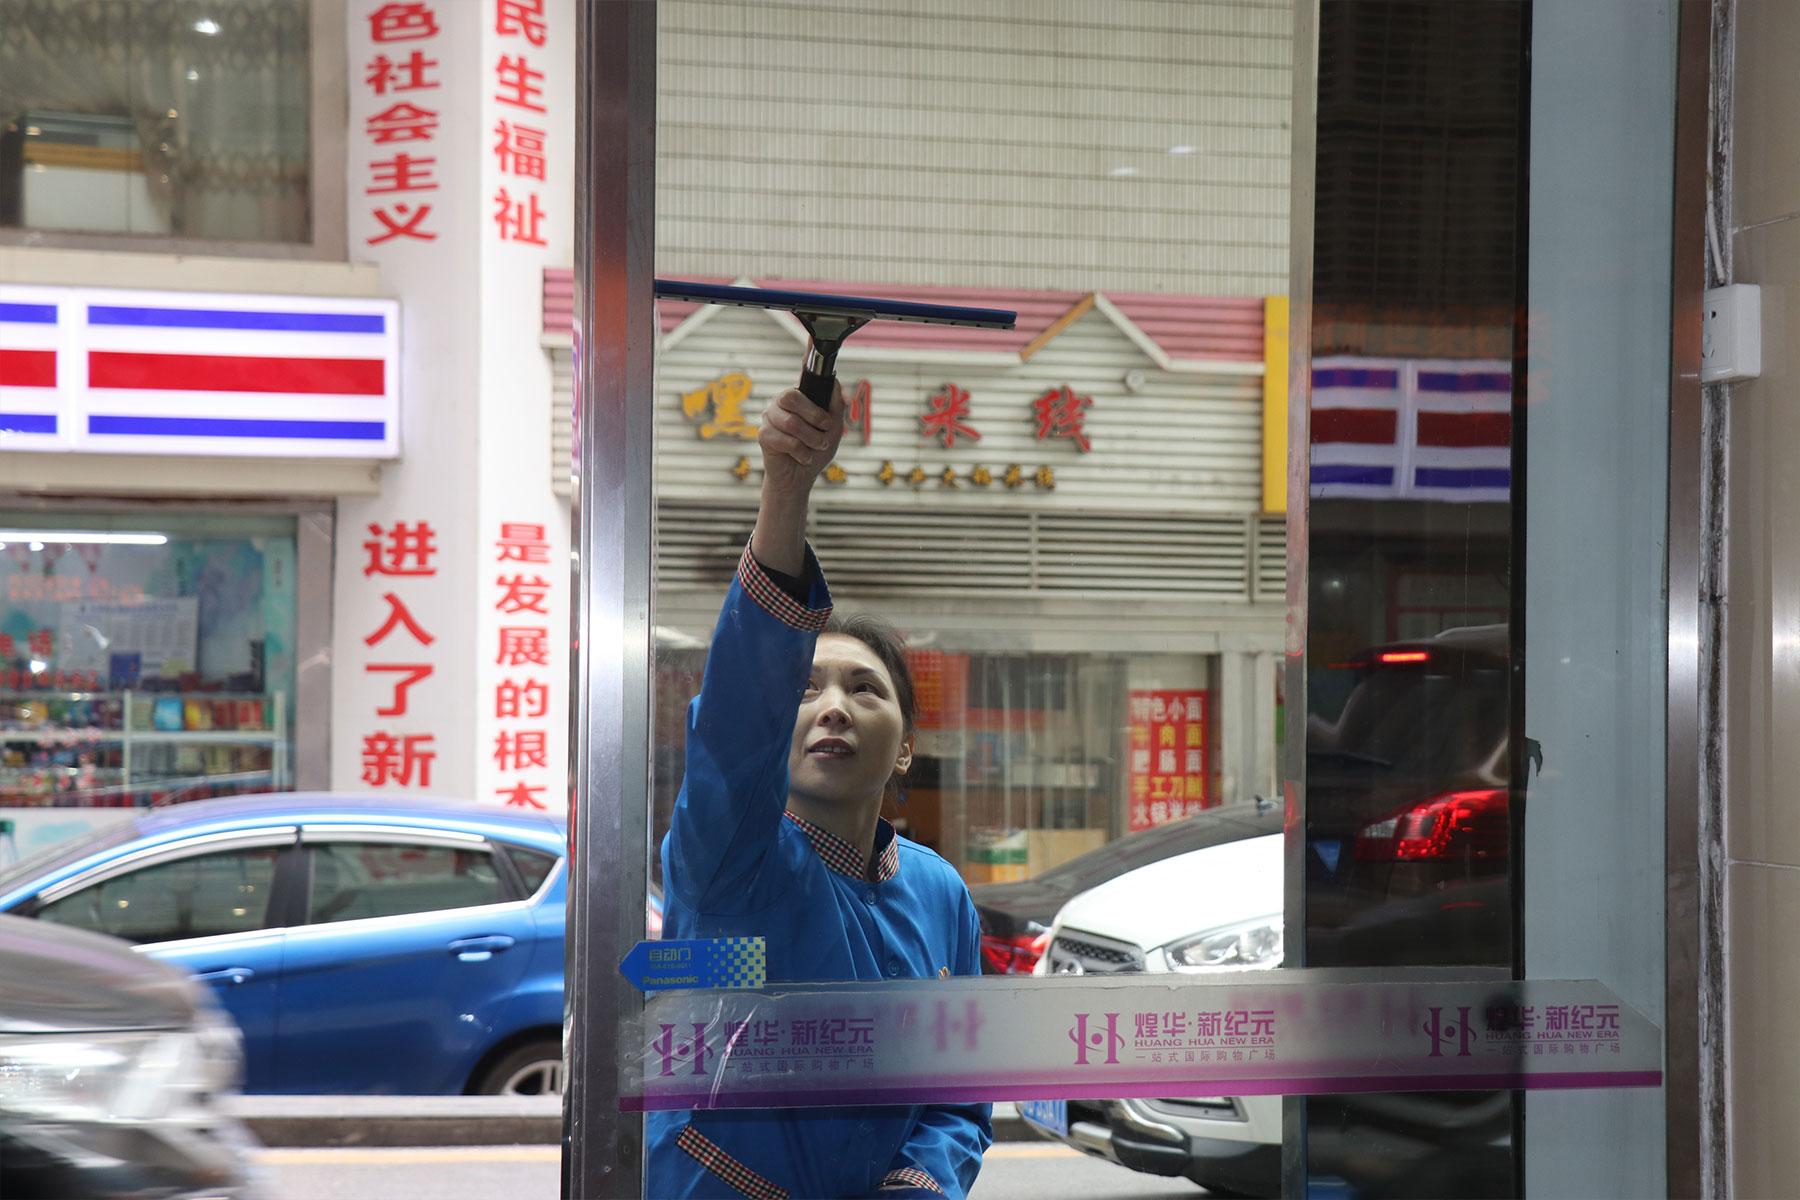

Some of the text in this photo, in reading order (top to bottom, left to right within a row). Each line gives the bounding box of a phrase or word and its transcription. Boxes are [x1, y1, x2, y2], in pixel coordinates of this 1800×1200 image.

[366, 2, 440, 245] 色社会主义
[493, 0, 549, 247] 民生福祉
[361, 520, 438, 790] 进入了新
[649, 947, 692, 961] 自动门
[643, 974, 699, 985] Panasonic
[1135, 1010, 1275, 1038] 煌华·新纪元
[1134, 1036, 1275, 1047] HUANG HUA NEW ERA
[1537, 1031, 1562, 1039] HUA
[1567, 1031, 1592, 1039] NEW
[1597, 1030, 1620, 1038] ERA
[781, 1047, 811, 1056] HUA
[815, 1046, 843, 1055] NEW
[848, 1045, 874, 1053] ERA
[1135, 1049, 1276, 1063] 一站式国际购物广场
